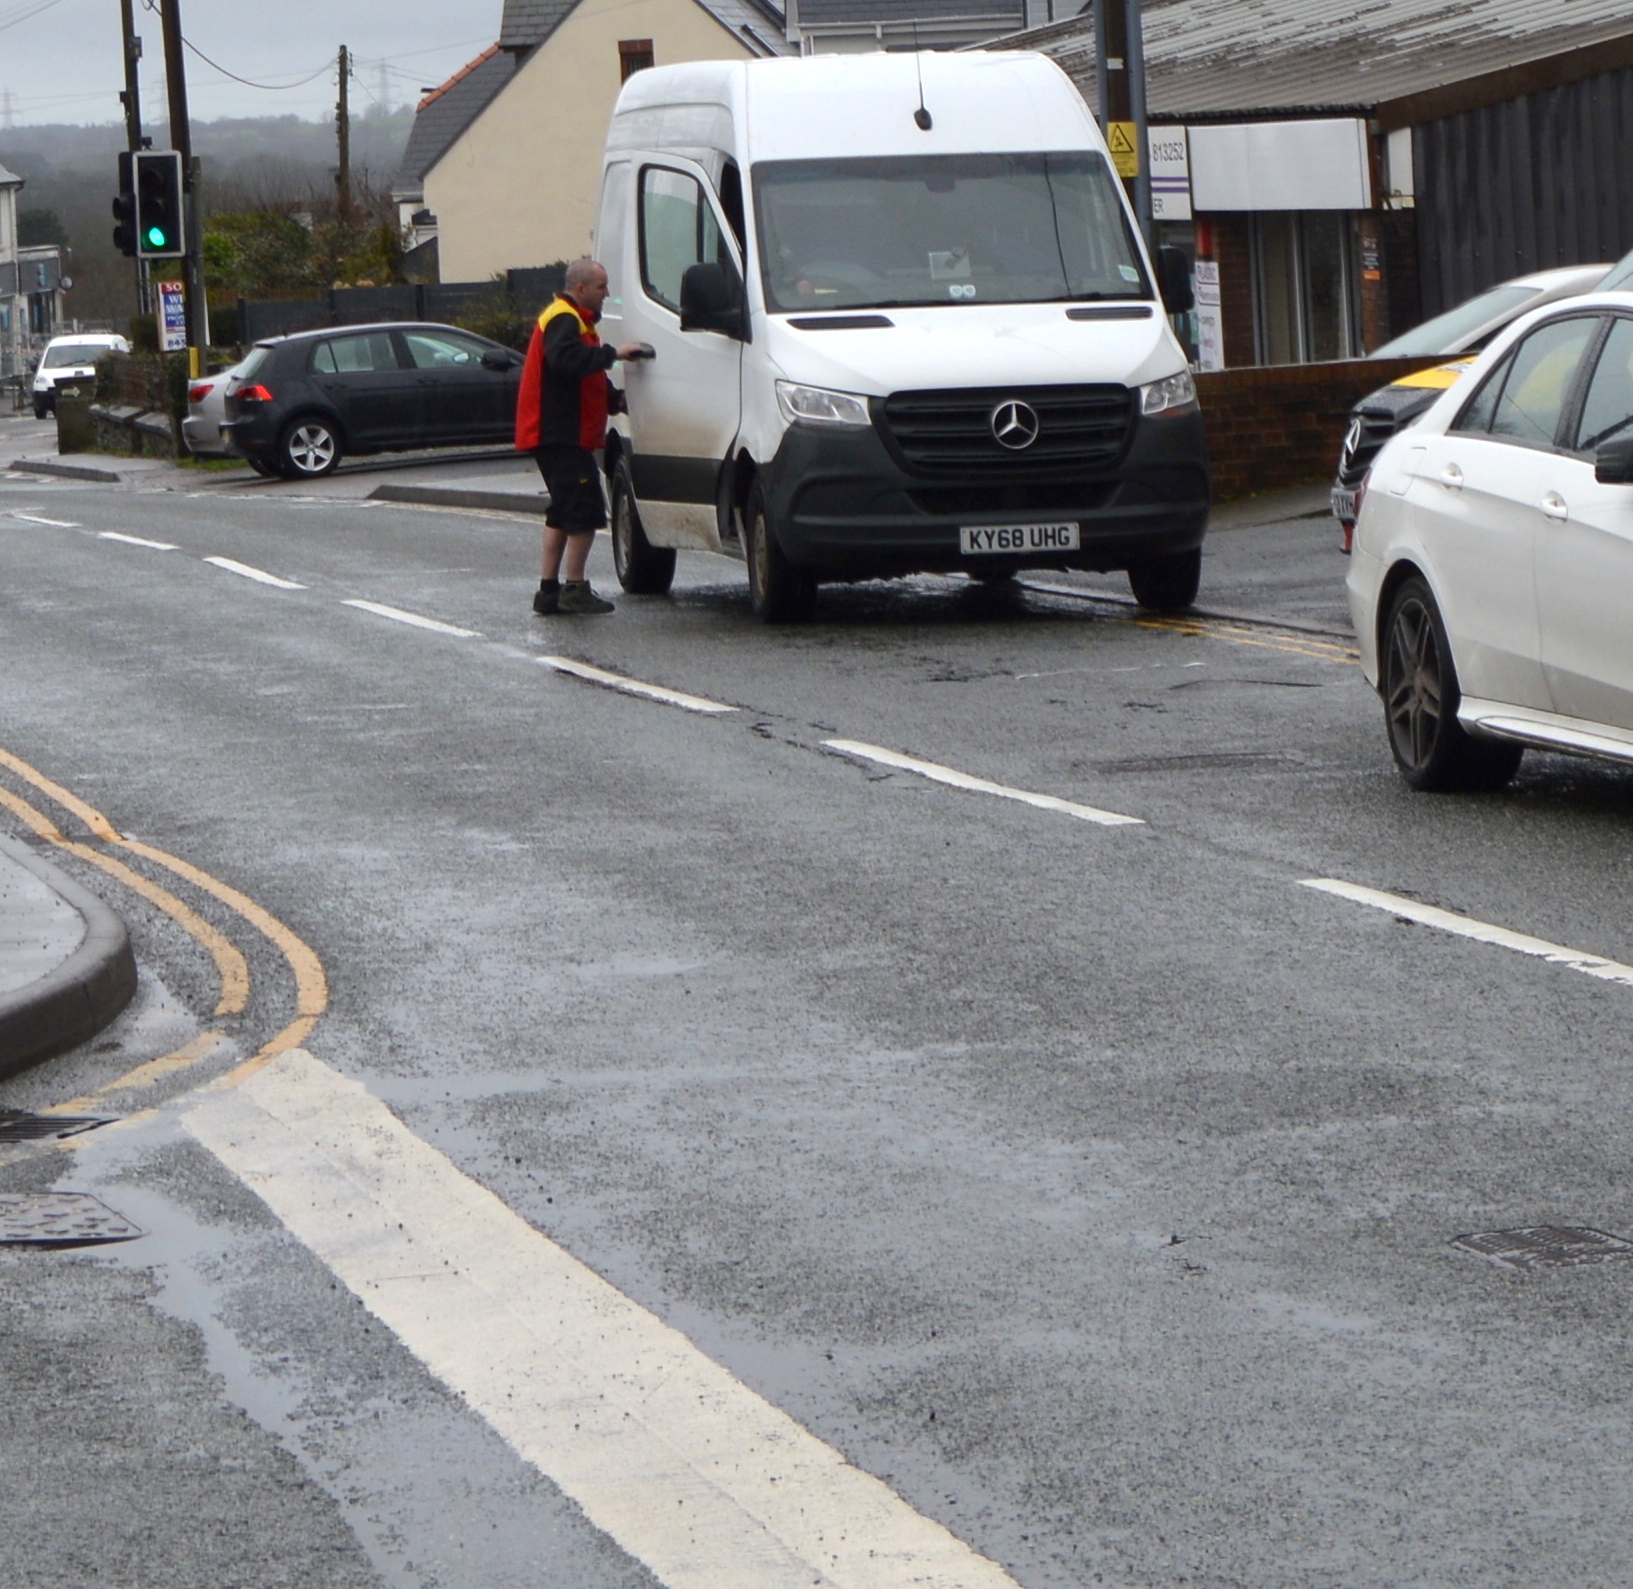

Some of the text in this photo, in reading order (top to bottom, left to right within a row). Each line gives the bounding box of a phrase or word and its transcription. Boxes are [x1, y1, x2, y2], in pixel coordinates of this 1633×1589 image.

[1152, 143, 1184, 162] 813252
[1152, 198, 1165, 214] ER
[969, 526, 1070, 550] KY68 UHG
